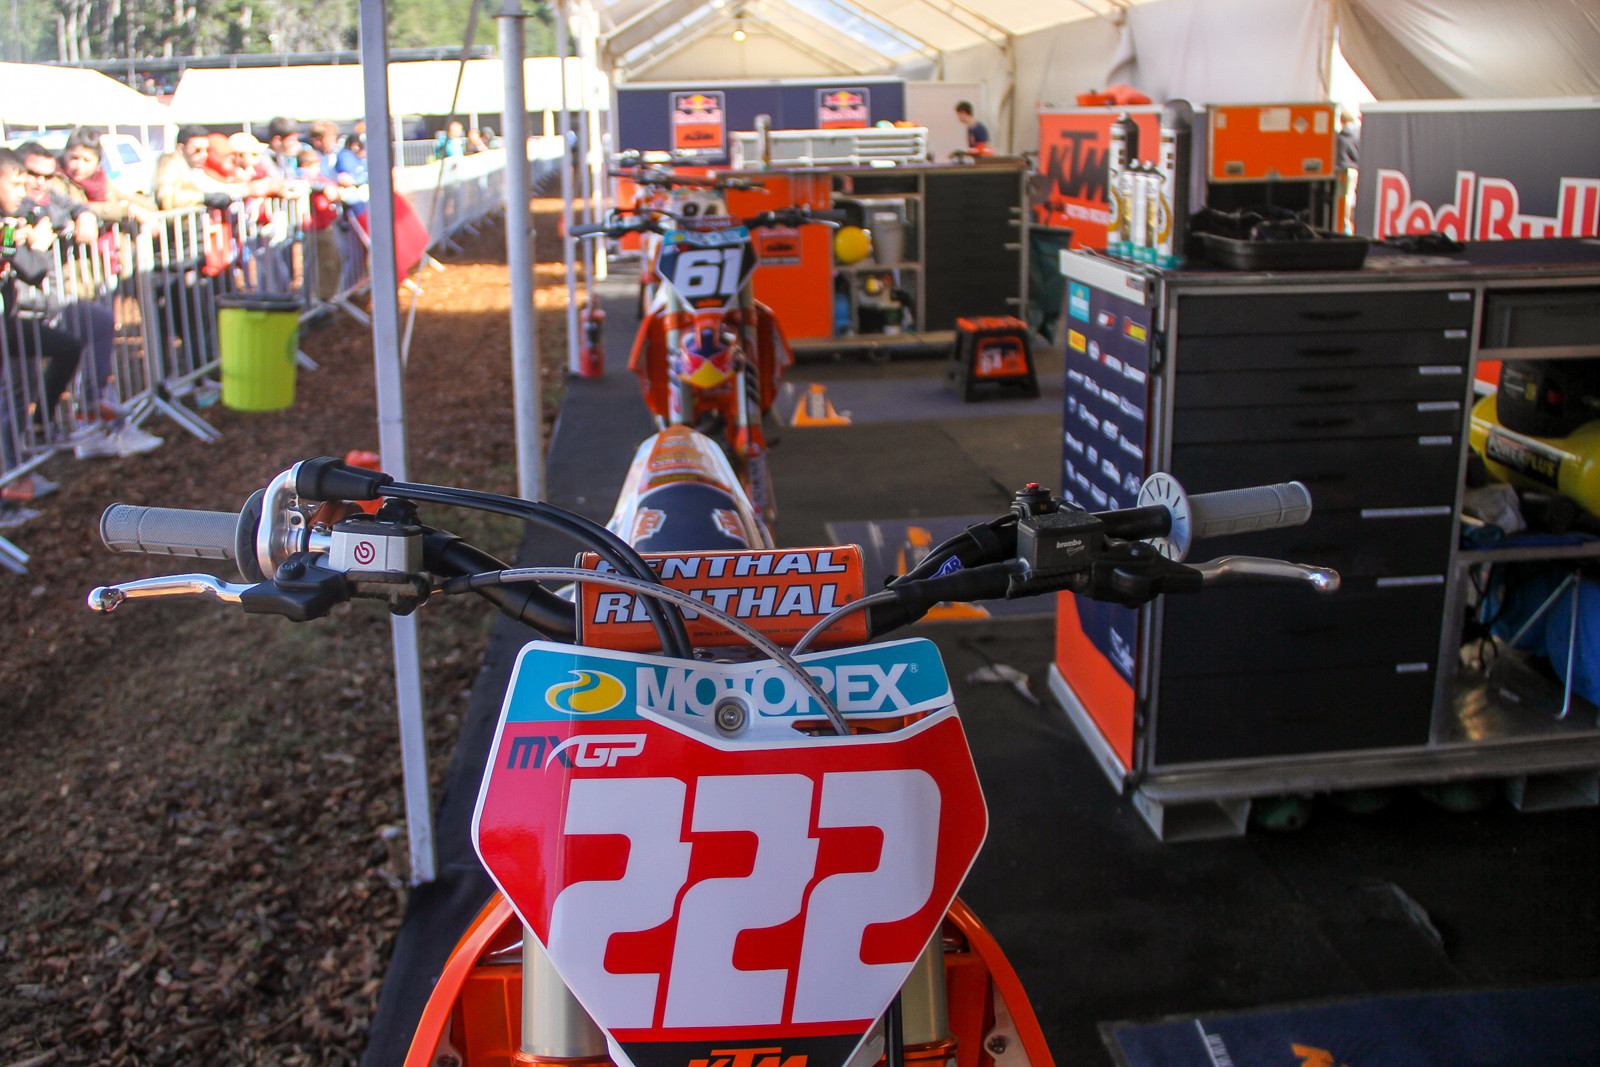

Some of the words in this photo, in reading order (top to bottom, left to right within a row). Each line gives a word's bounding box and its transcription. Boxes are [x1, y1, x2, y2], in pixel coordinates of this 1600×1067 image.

[1374, 169, 1476, 242] Red
[674, 248, 743, 298] 61
[594, 552, 848, 579] RNTHAL
[1056, 538, 1082, 549] brembo
[506, 733, 648, 775] MXGP
[547, 769, 942, 1030] 222
